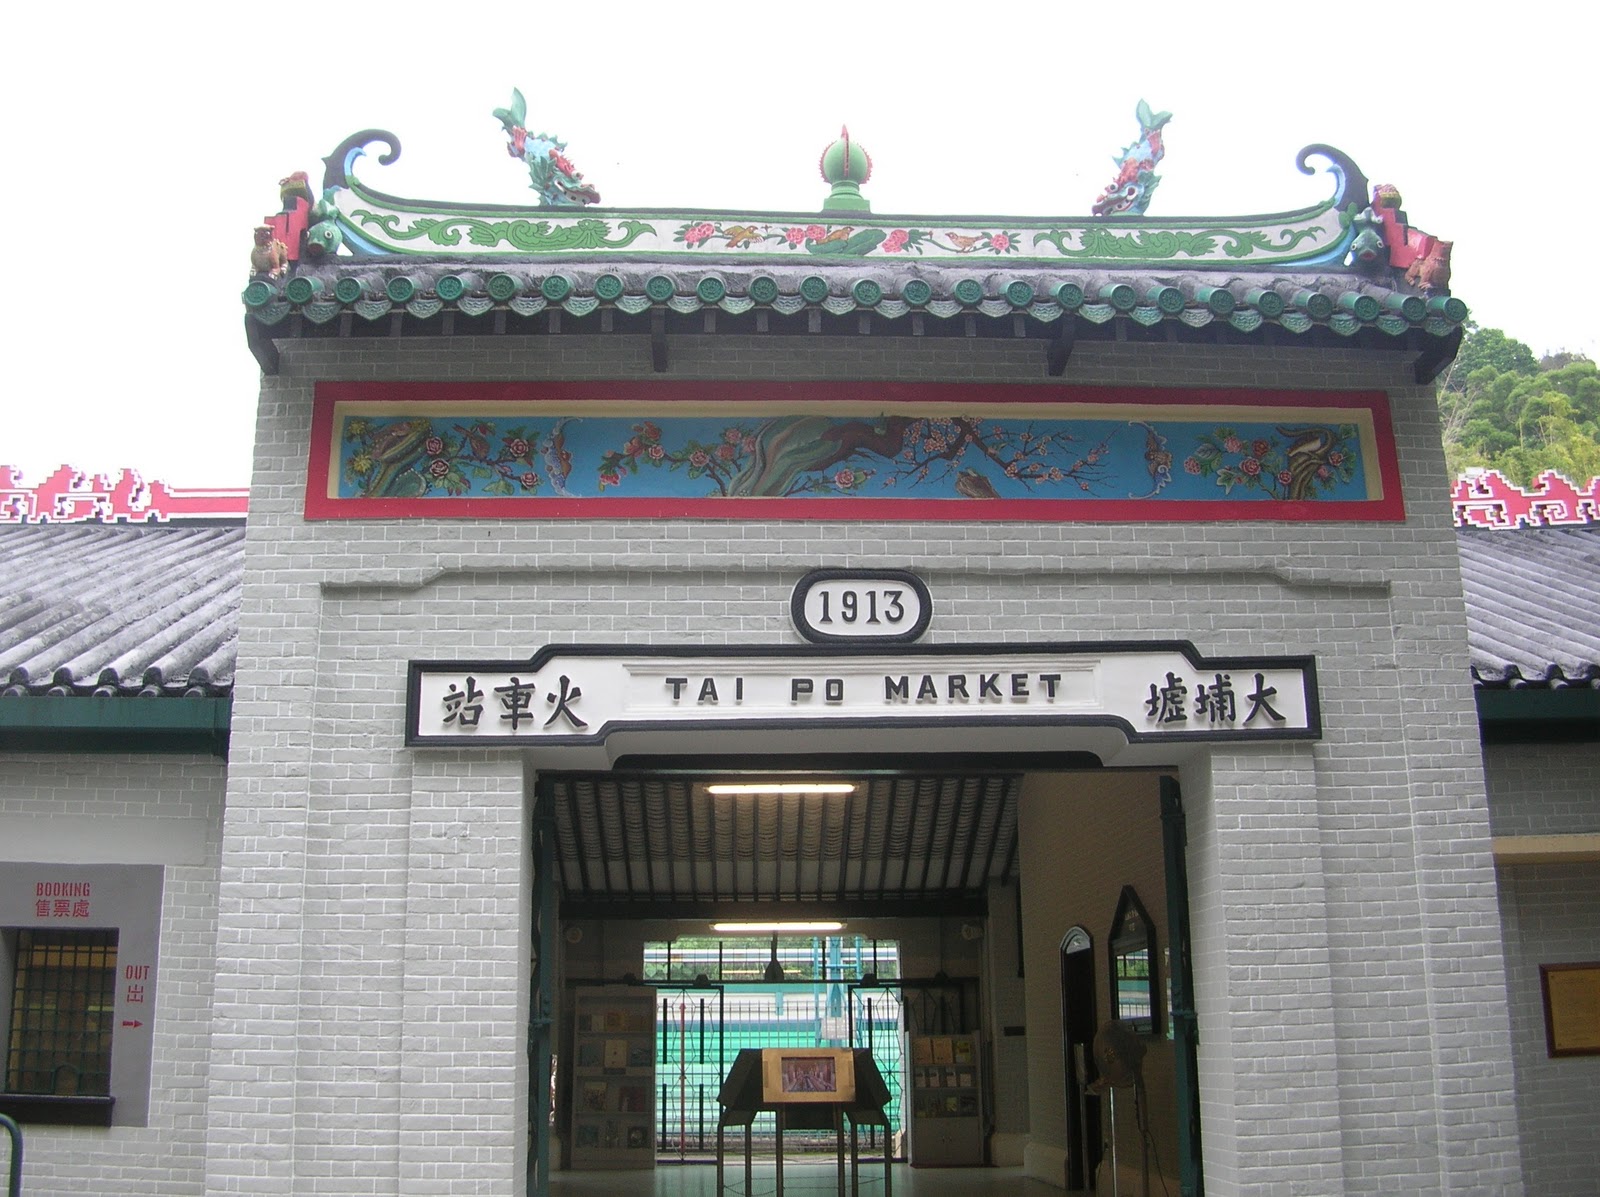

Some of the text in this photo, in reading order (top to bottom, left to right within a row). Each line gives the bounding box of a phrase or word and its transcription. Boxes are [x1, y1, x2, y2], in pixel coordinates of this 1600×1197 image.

[820, 590, 905, 624] 1913
[665, 673, 1062, 702] TAI PO MARKET
[36, 881, 90, 898] BOOKING
[35, 899, 90, 917] 售票處
[125, 964, 150, 981] OUT
[126, 984, 144, 1003] 出
